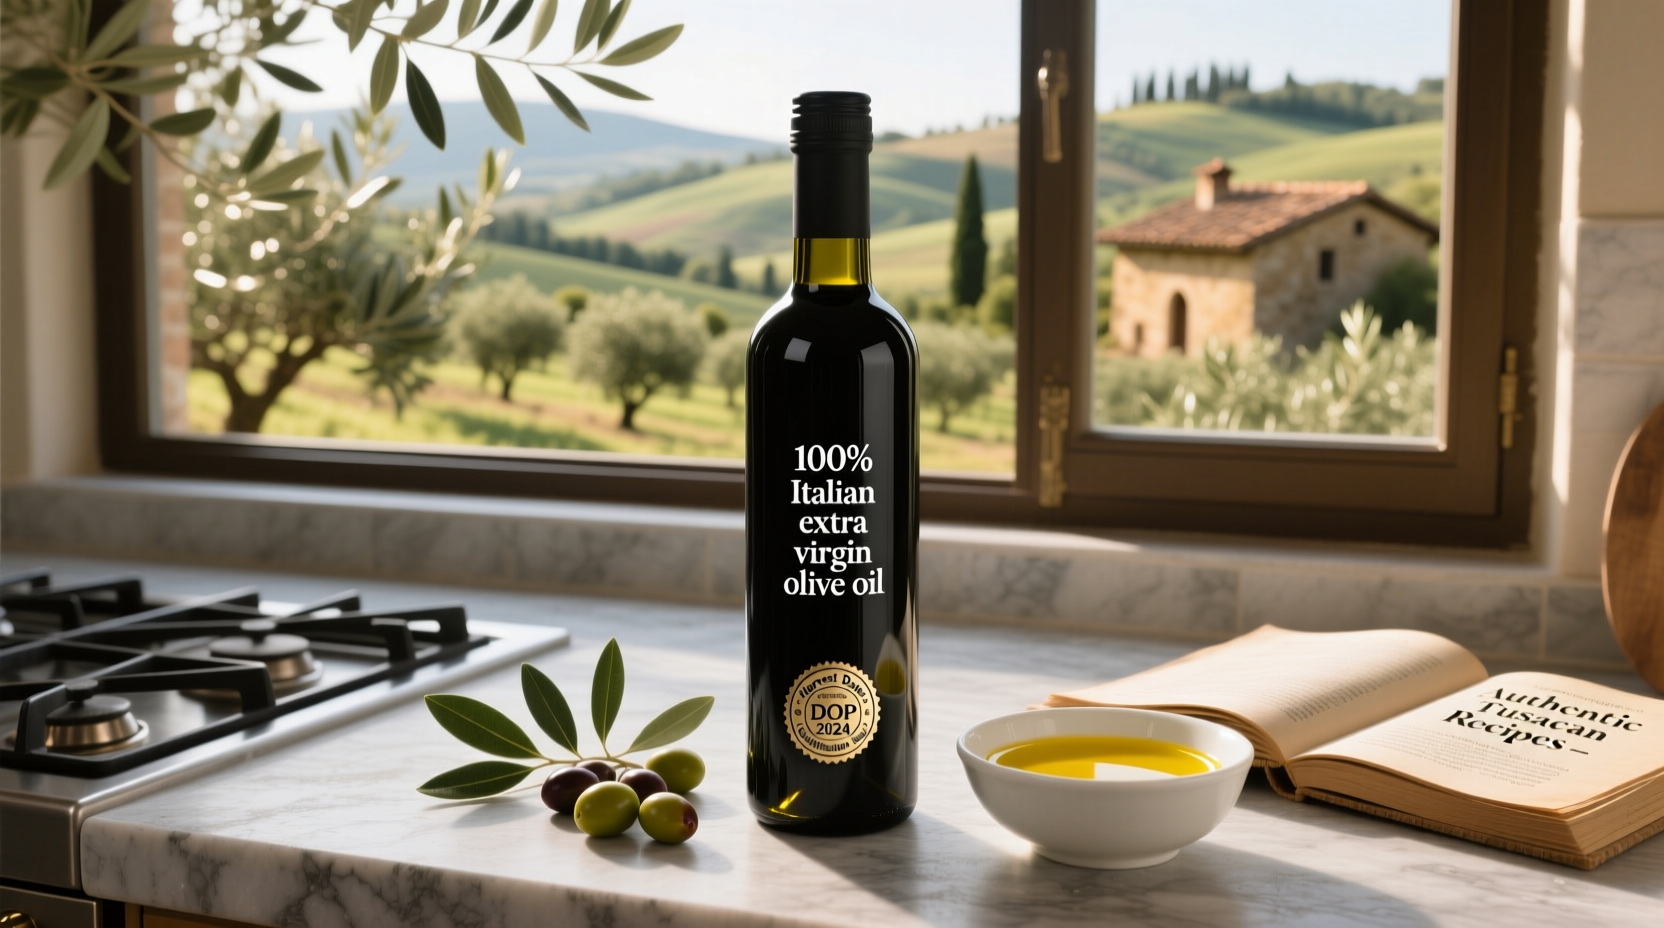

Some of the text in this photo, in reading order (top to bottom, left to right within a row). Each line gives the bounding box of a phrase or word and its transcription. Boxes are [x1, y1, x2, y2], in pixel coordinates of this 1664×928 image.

[794, 443, 873, 472] 100%
[790, 479, 876, 505] Italian
[799, 512, 869, 534] extra
[793, 539, 873, 573] virgin
[783, 567, 885, 597] olive oil
[811, 703, 857, 721] DOP
[1478, 687, 1644, 733] Authentic
[1478, 700, 1608, 742] Tusacan
[816, 722, 850, 736] 2024
[1443, 709, 1567, 750] Recipes
